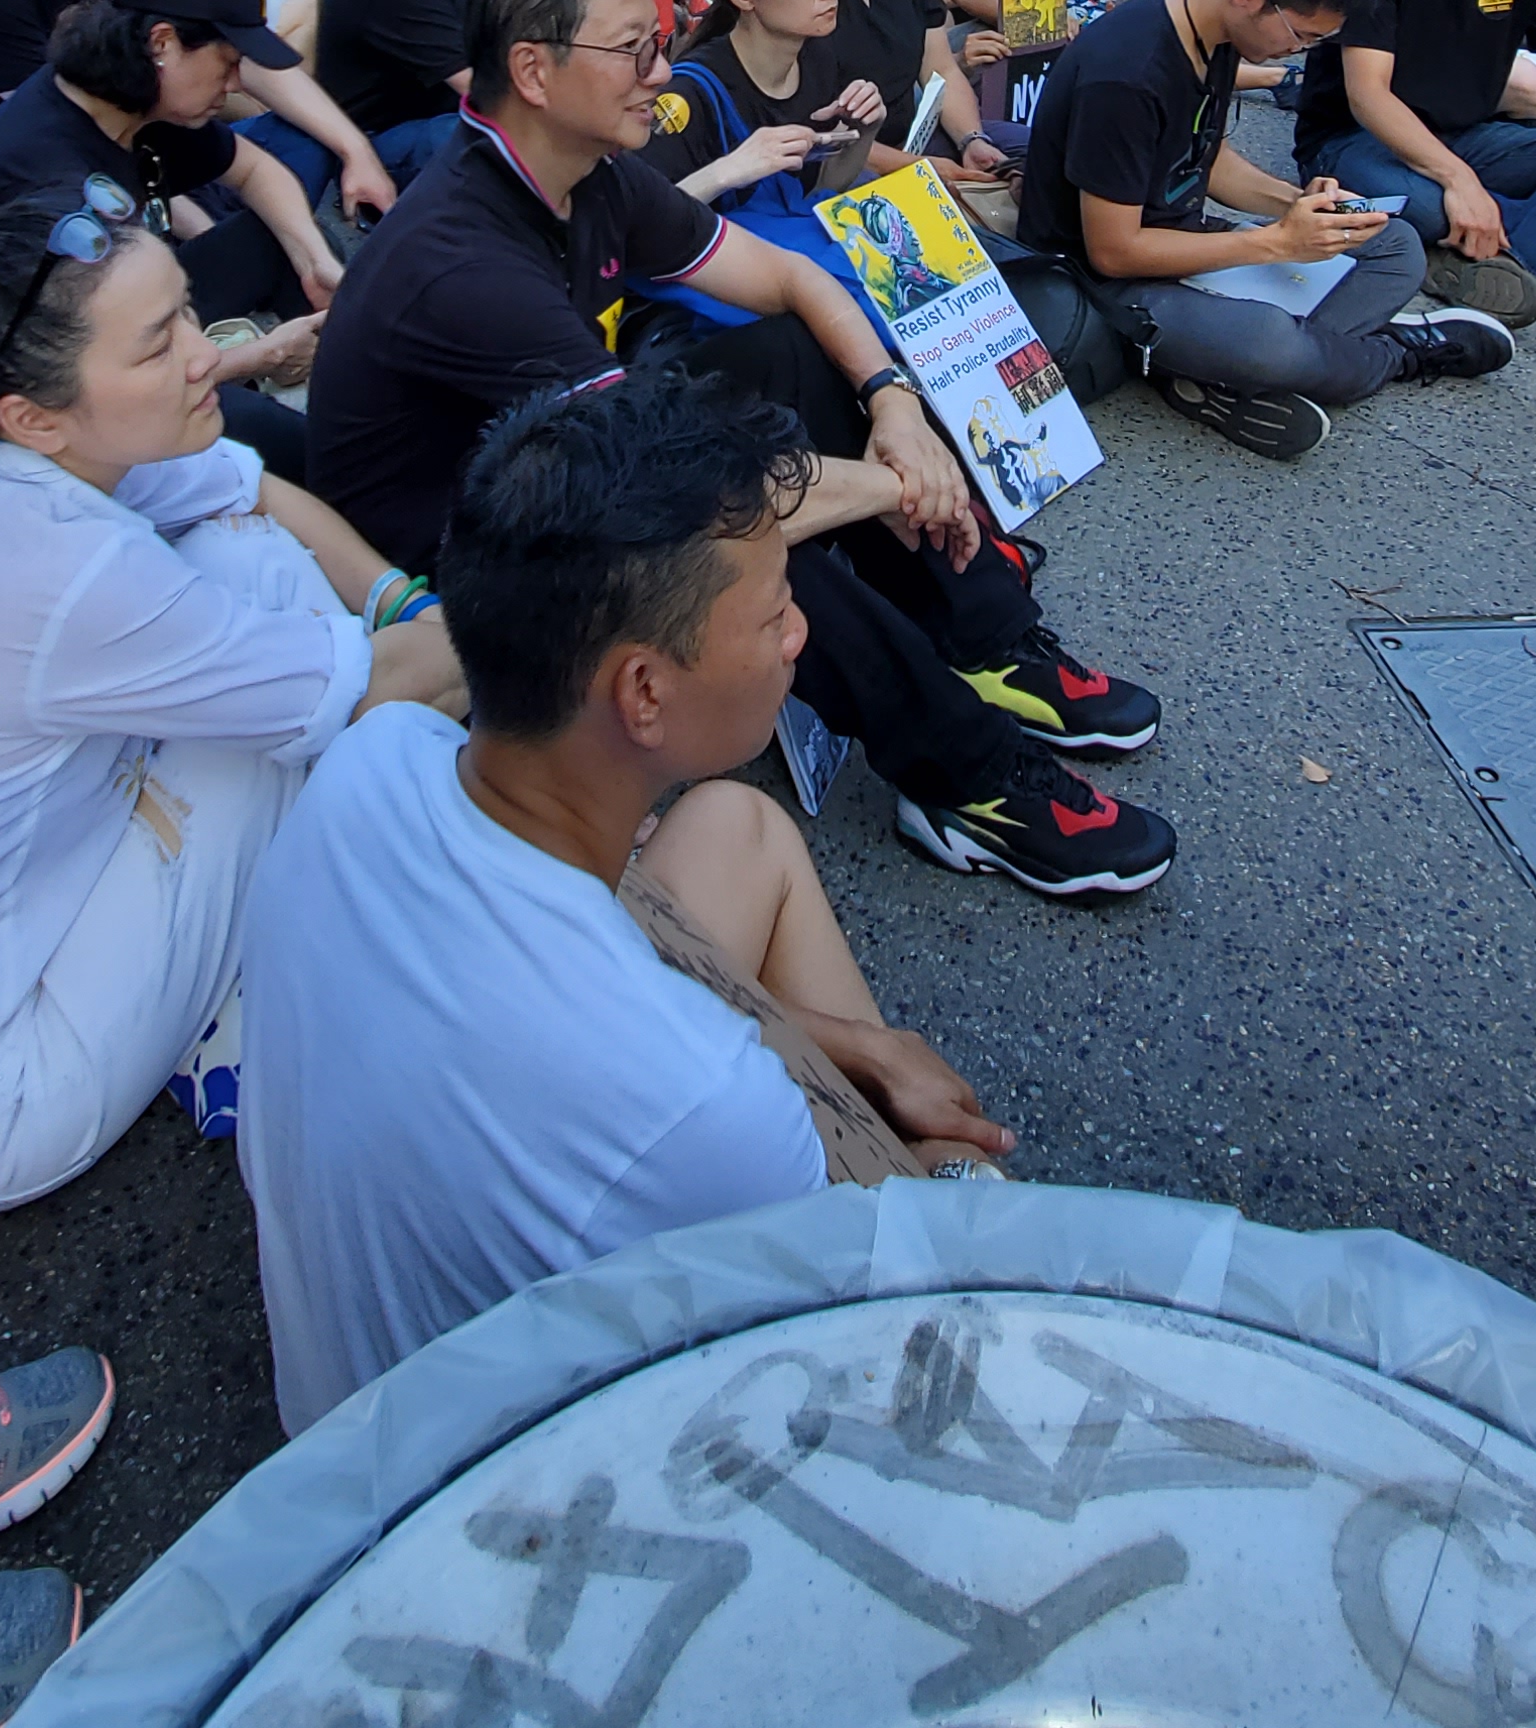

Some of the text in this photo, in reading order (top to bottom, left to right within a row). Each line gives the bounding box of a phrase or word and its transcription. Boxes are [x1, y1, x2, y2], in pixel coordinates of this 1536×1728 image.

[893, 275, 1003, 343] Resist Tyranny
[912, 303, 1017, 369] Stop Gang Violence
[926, 325, 1032, 395] Halt Police Brutality
